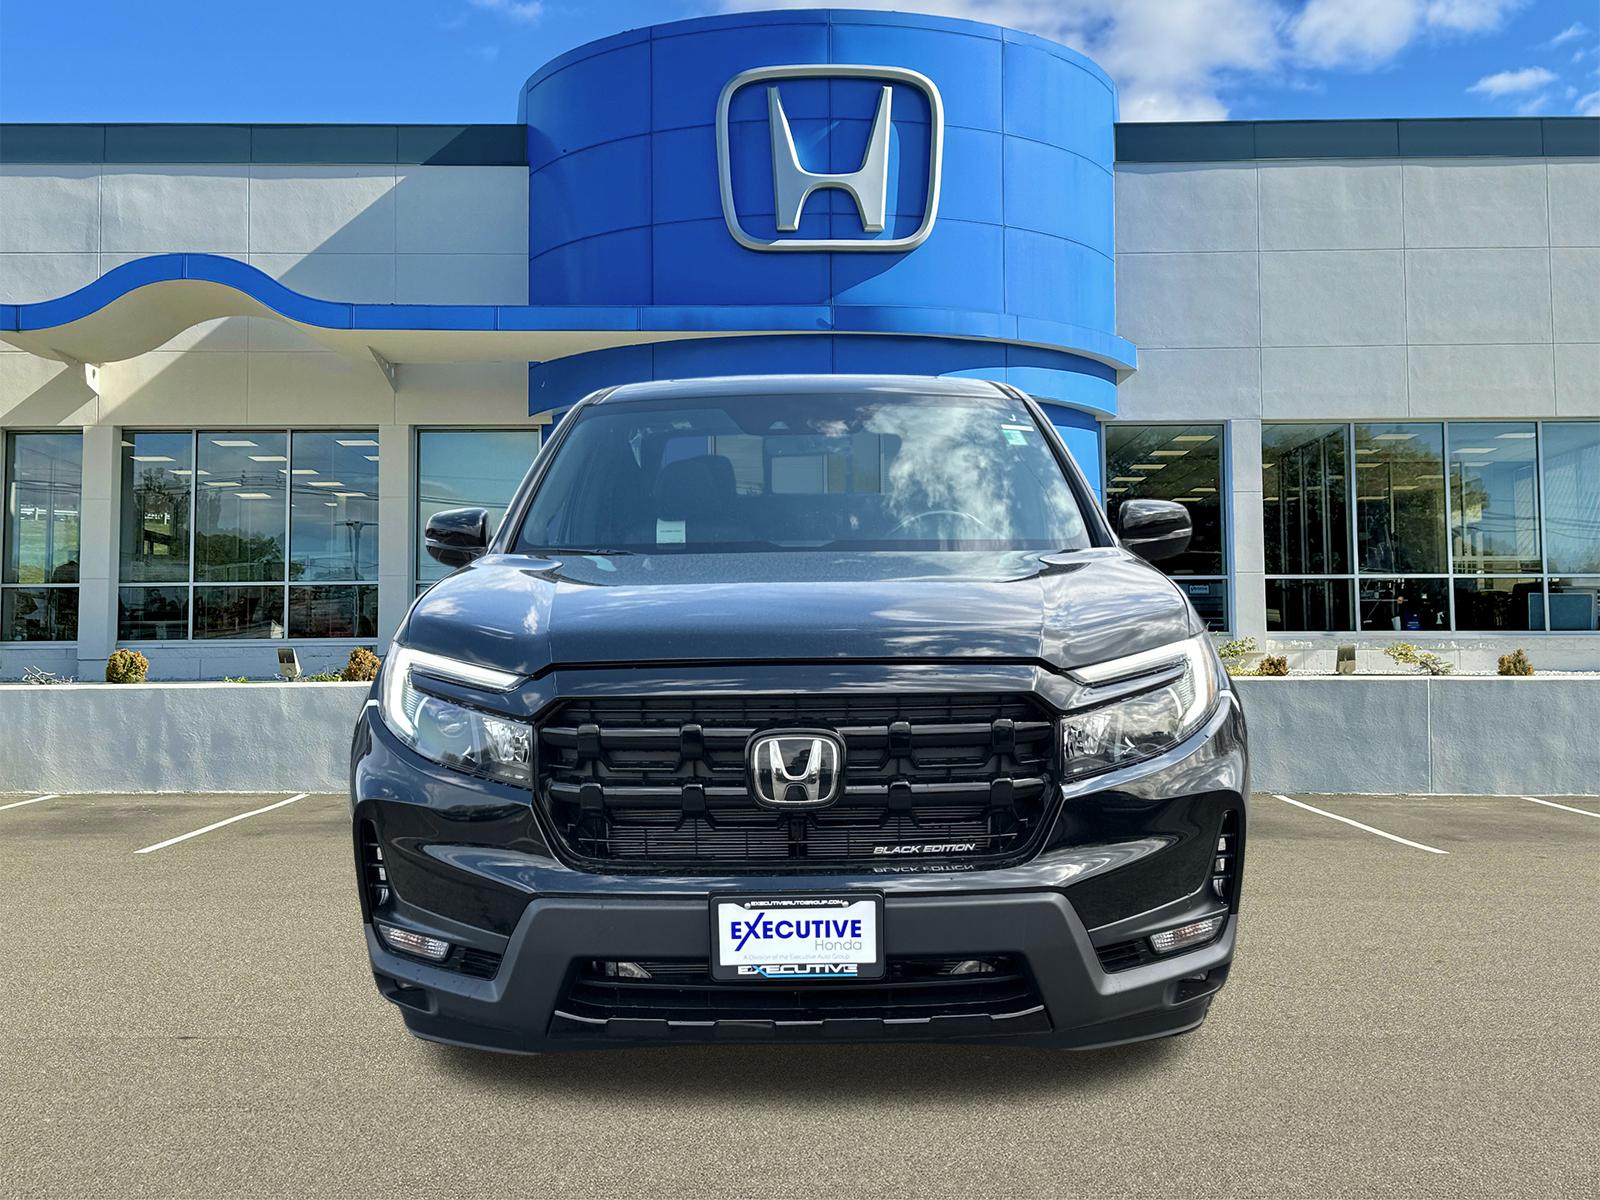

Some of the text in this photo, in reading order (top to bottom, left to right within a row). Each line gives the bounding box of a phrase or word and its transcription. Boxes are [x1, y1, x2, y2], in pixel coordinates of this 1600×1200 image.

[767, 86, 893, 232] H
[769, 740, 822, 801] H
[873, 843, 976, 854] BLACK EDITION
[731, 912, 862, 951] EXECUTIVE
[815, 939, 862, 951] Honda
[738, 963, 858, 976] EXECUTIVE
